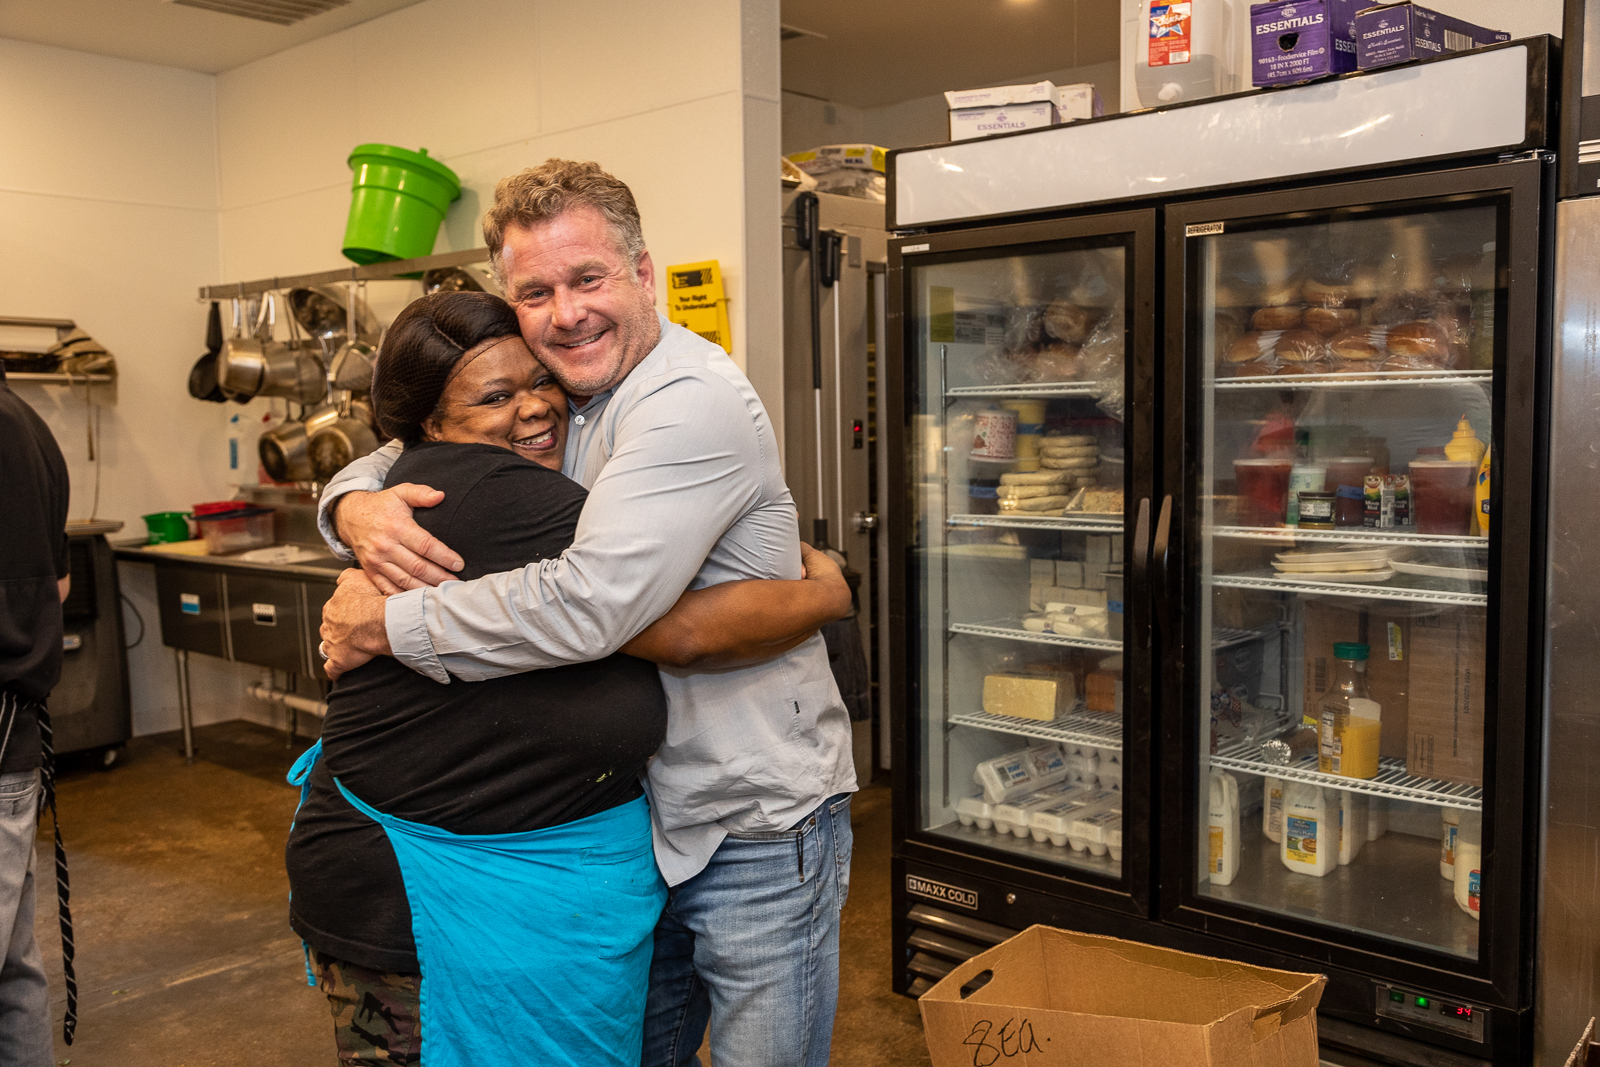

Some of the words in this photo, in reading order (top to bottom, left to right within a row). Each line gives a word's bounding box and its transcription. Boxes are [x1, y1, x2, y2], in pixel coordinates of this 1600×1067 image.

[1256, 14, 1324, 35] ESSENTIALS
[1363, 24, 1405, 40] ESSENTIALS
[1335, 38, 1357, 53] ESSEN
[1415, 37, 1442, 52] ESSENTIALS
[1278, 52, 1307, 61] Foodservice
[978, 122, 1026, 130] ESSENTIALS
[1188, 224, 1222, 233] REFRIGERATOR
[683, 302, 716, 310] Understand
[918, 881, 946, 898] MAXX
[948, 889, 975, 905] COLD
[1457, 1007, 1471, 1016] 34
